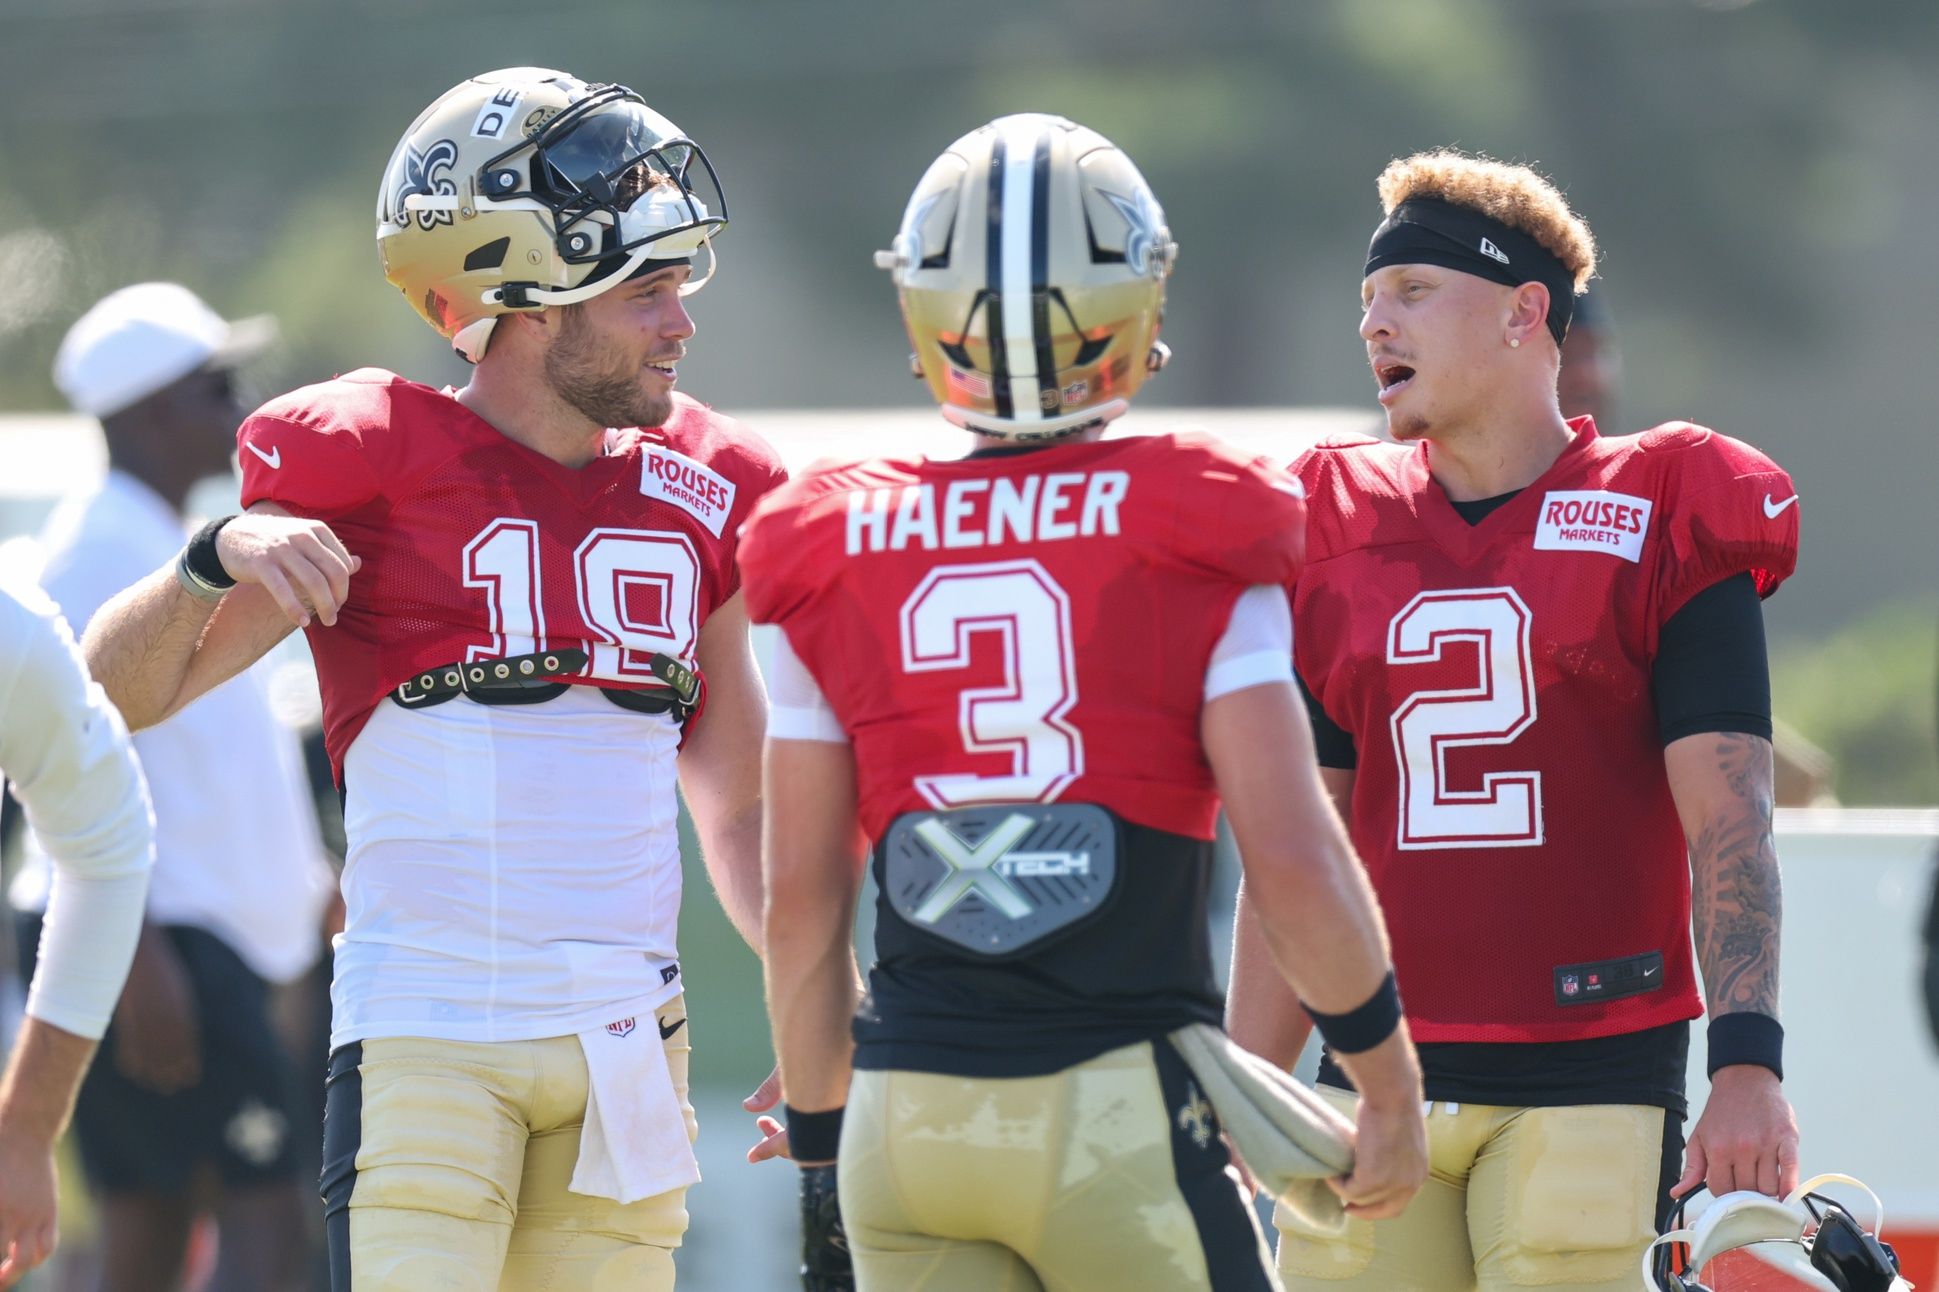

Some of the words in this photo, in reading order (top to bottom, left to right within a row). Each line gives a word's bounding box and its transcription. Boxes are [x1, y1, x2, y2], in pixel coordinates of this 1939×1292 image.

[648, 454, 728, 511] ROUSES
[663, 482, 711, 517] MARKETS
[846, 471, 1130, 555] HAENER
[1546, 501, 1643, 534] ROUSES
[1559, 528, 1620, 545] MARKETS
[901, 558, 1085, 811] 3
[1386, 586, 1543, 850] 2
